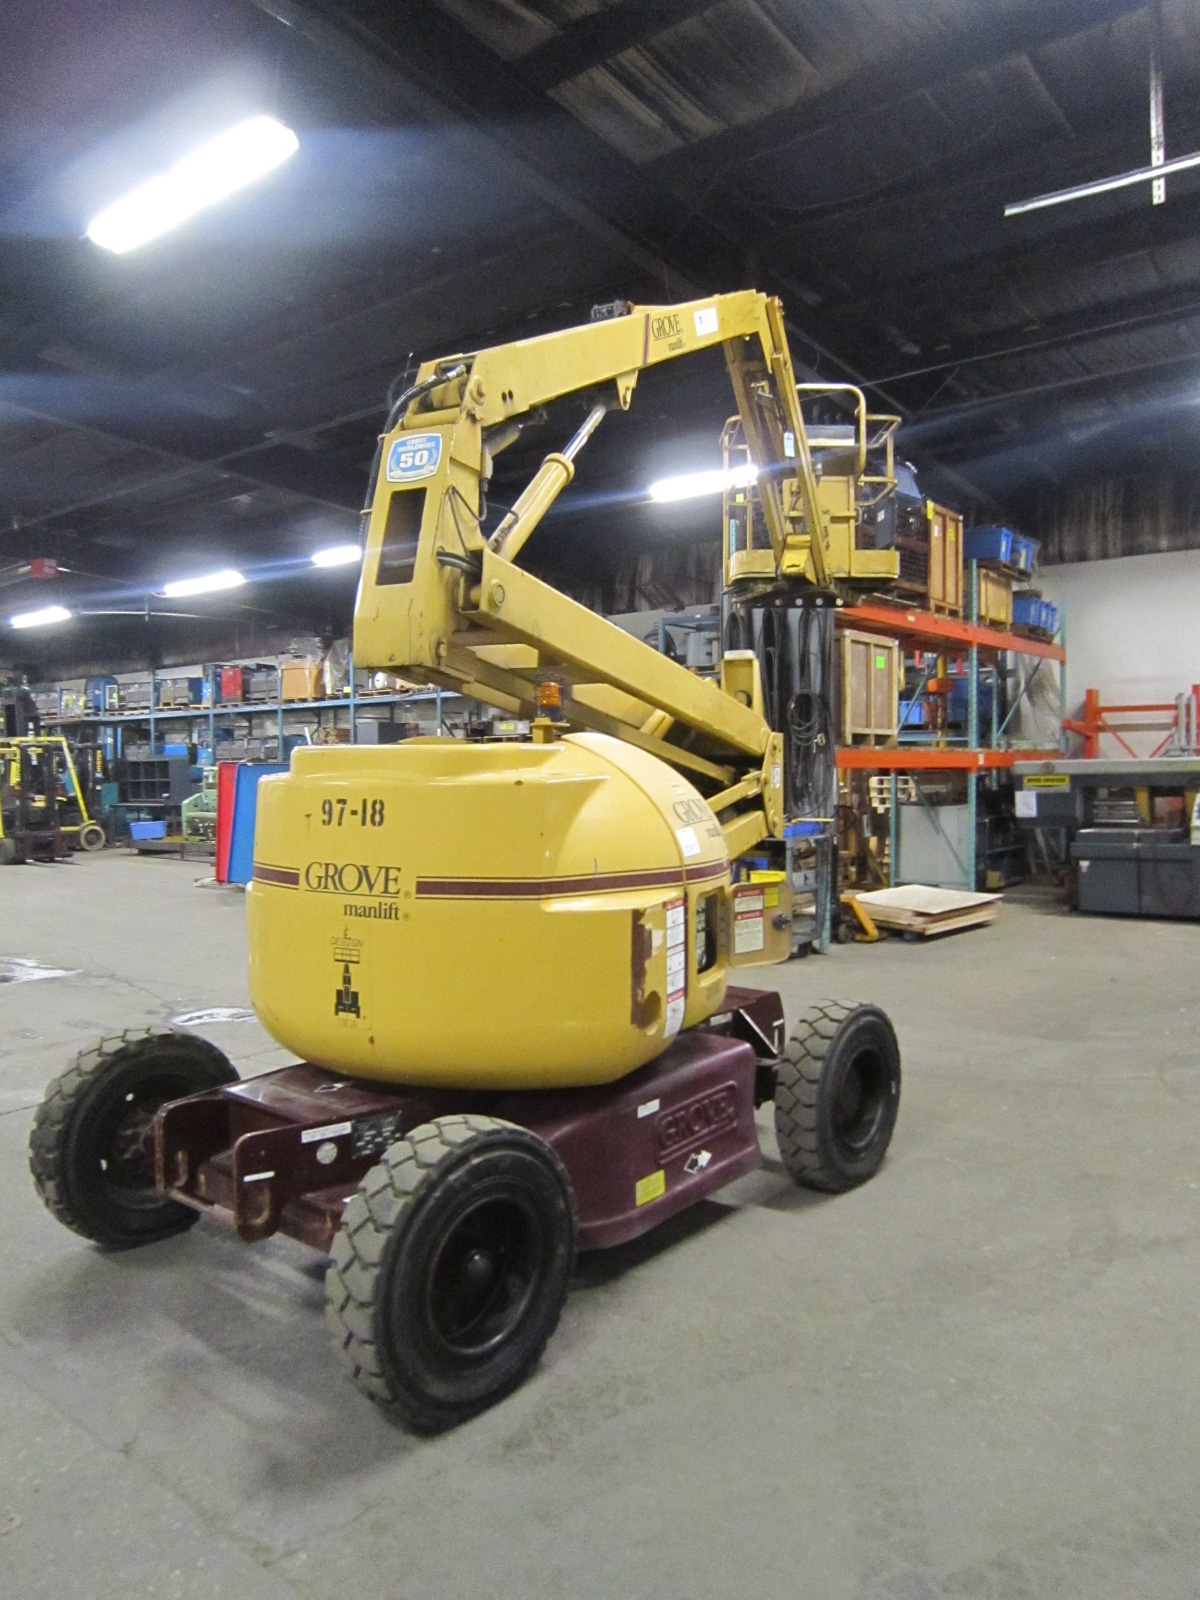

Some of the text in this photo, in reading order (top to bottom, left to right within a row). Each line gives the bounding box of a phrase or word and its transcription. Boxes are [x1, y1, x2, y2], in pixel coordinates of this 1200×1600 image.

[652, 314, 681, 339] GROVE
[399, 450, 429, 468] 50
[321, 799, 384, 827] 97-18
[305, 862, 402, 895] GROVE
[343, 902, 399, 920] manlift
